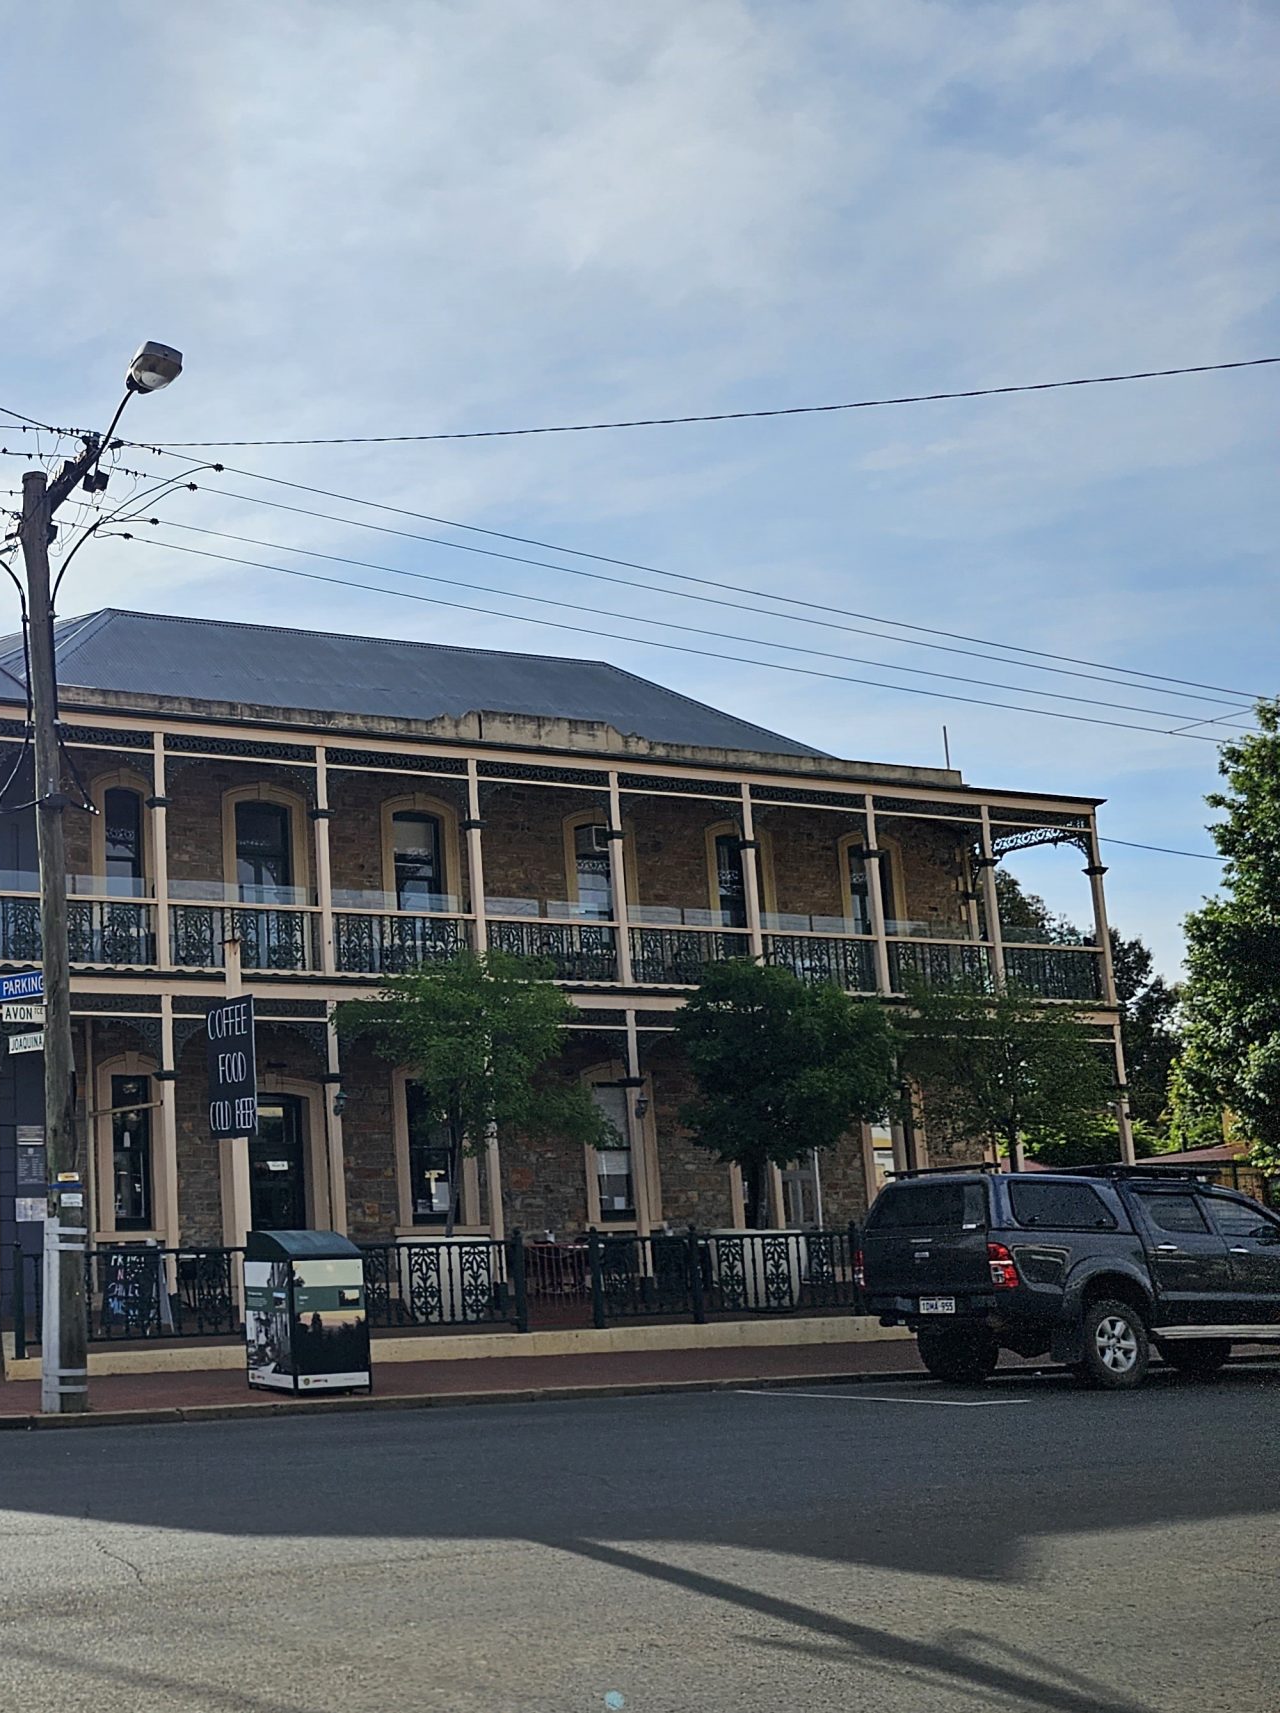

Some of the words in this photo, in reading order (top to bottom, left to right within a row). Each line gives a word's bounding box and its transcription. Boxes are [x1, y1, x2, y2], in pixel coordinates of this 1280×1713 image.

[3, 976, 44, 996] PARKING
[5, 1006, 33, 1020] AVON
[34, 1007, 43, 1015] TCE
[207, 1003, 248, 1040] COFFEE
[11, 1035, 42, 1052] JOAQUINA
[218, 1051, 247, 1084] FOOD
[209, 1100, 231, 1131] COLD
[235, 1097, 257, 1131] BEER
